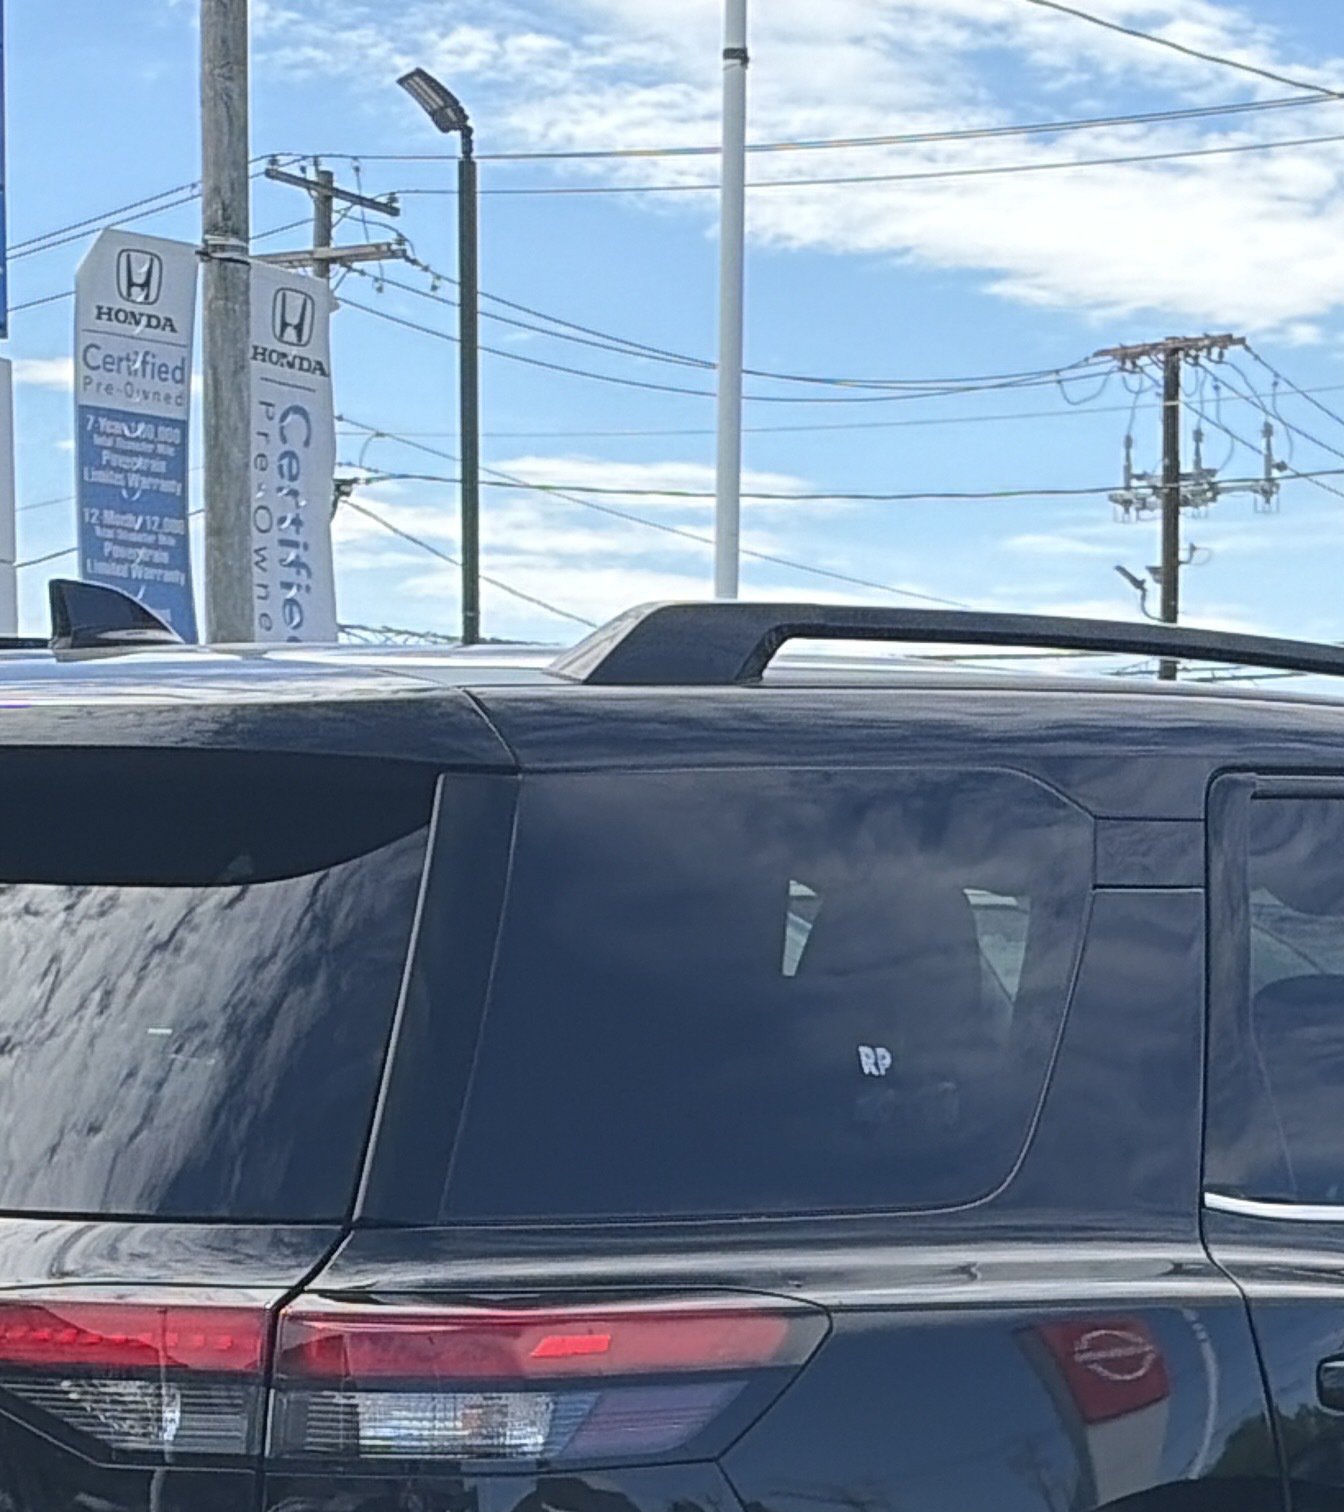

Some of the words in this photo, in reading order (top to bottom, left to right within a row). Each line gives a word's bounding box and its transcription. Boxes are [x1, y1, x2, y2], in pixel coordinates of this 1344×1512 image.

[94, 304, 178, 334] HONDA
[82, 342, 186, 385] Certified
[250, 344, 330, 378] HONDA
[82, 374, 184, 407] Pre-Owned
[253, 400, 276, 636] Pre-Owne
[277, 404, 313, 643] Certifie
[857, 1045, 893, 1077] RP
